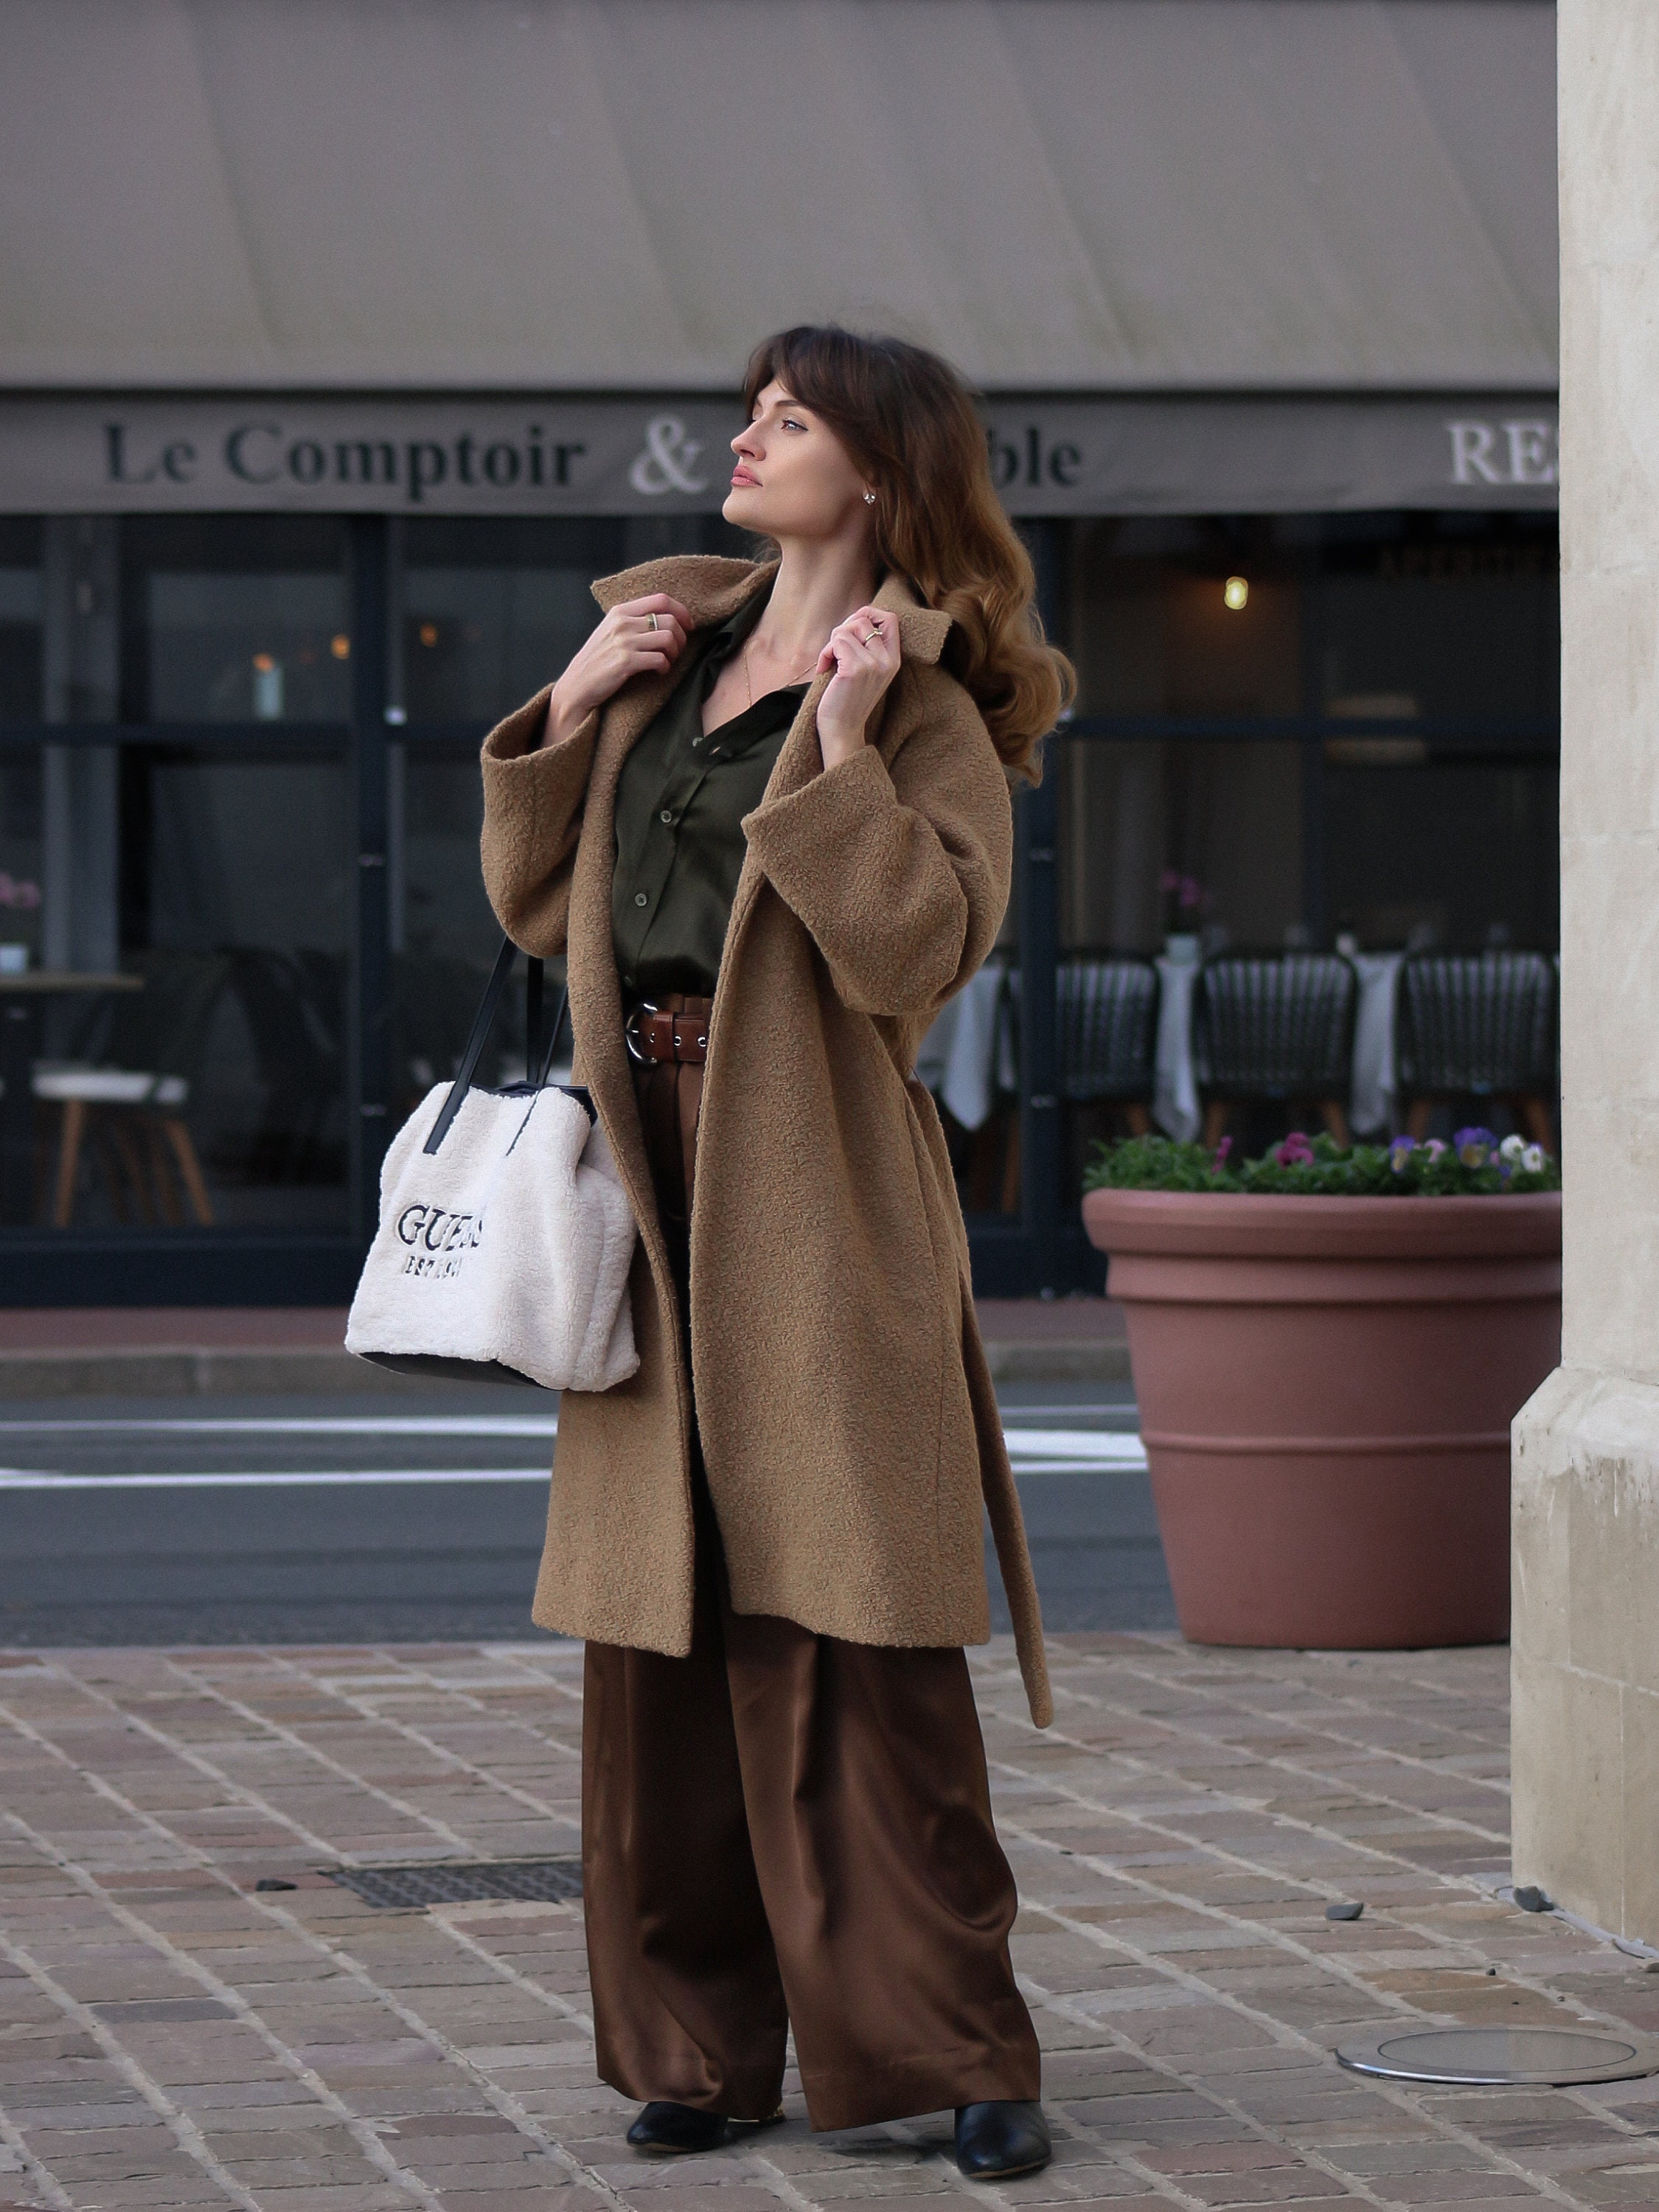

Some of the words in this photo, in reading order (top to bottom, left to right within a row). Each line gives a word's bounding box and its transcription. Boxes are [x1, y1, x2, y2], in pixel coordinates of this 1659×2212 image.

[105, 422, 196, 484] Le
[224, 422, 586, 503] Comptoir
[630, 414, 708, 495] &
[1447, 420, 1559, 484] RE
